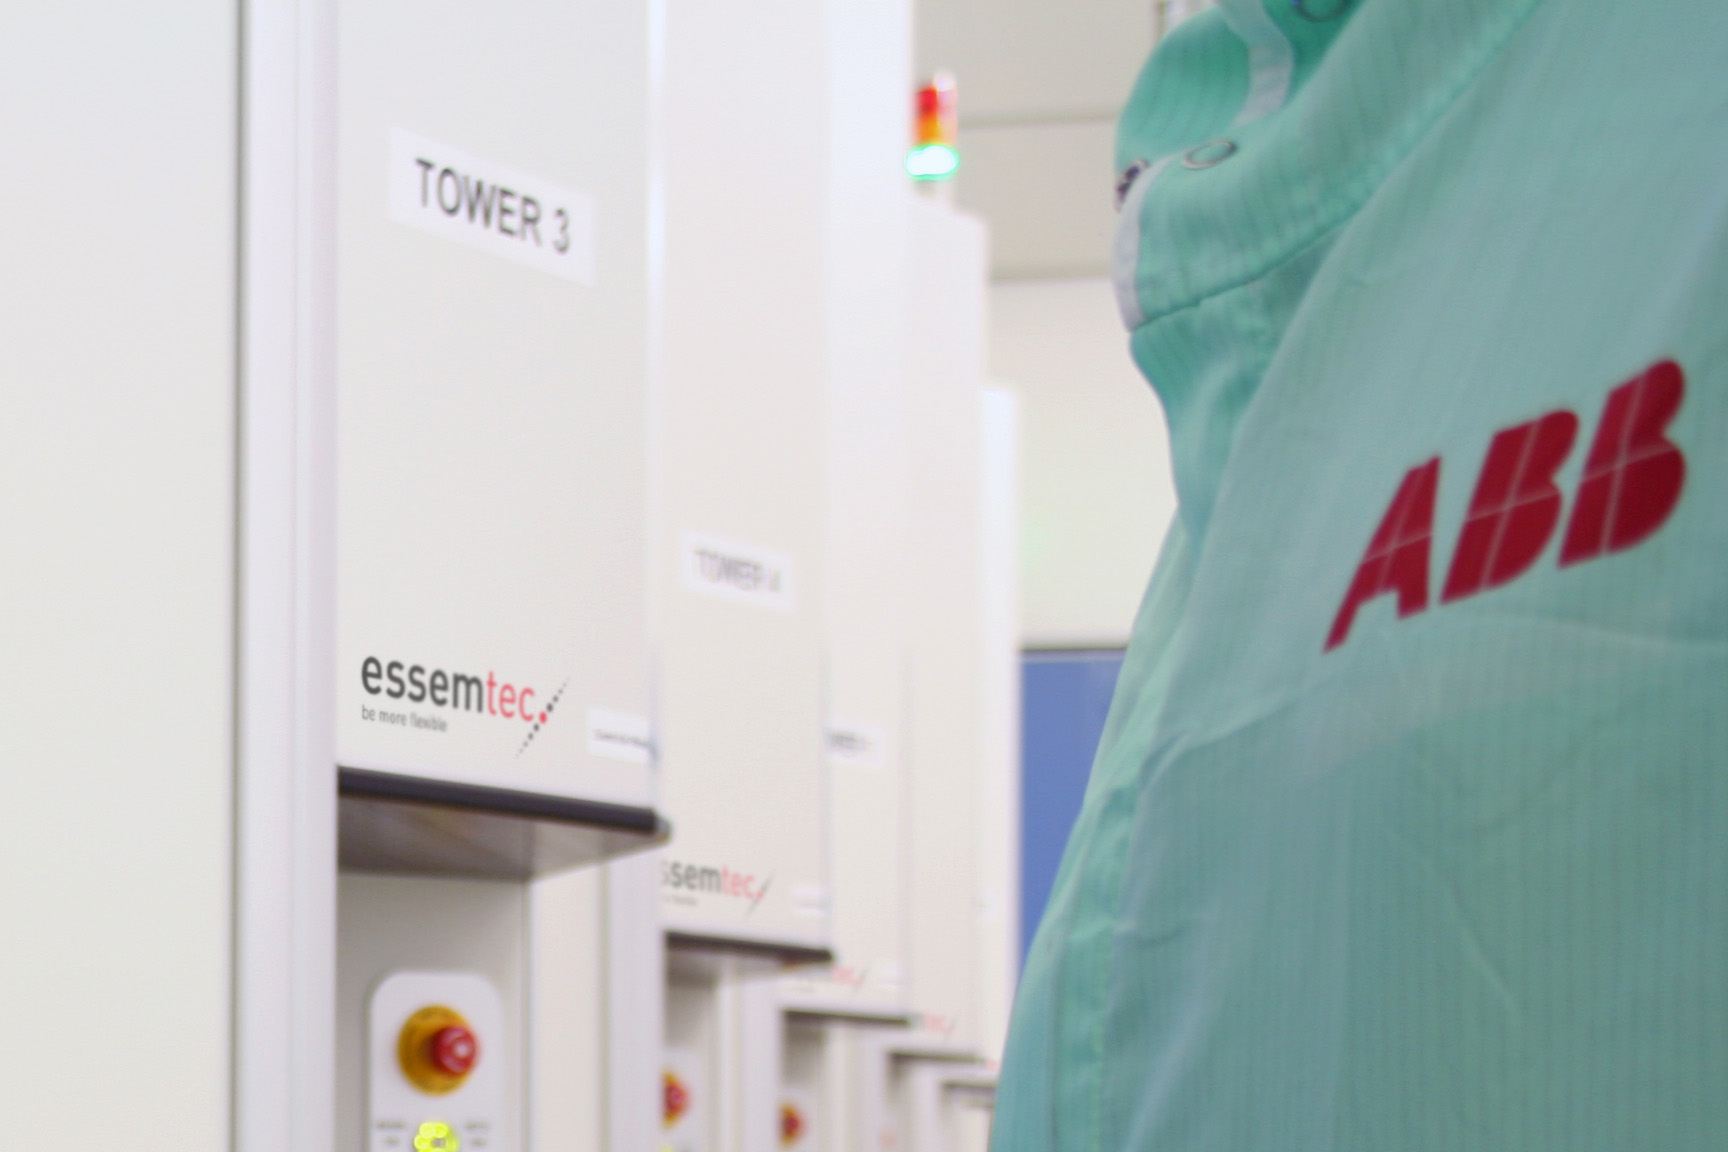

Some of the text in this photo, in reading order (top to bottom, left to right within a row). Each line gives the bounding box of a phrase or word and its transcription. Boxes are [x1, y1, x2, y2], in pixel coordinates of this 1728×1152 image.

[415, 156, 570, 255] TOWER 3
[1323, 357, 1687, 654] ABB
[361, 656, 535, 722] essemtec
[362, 705, 448, 733] be more flexible
